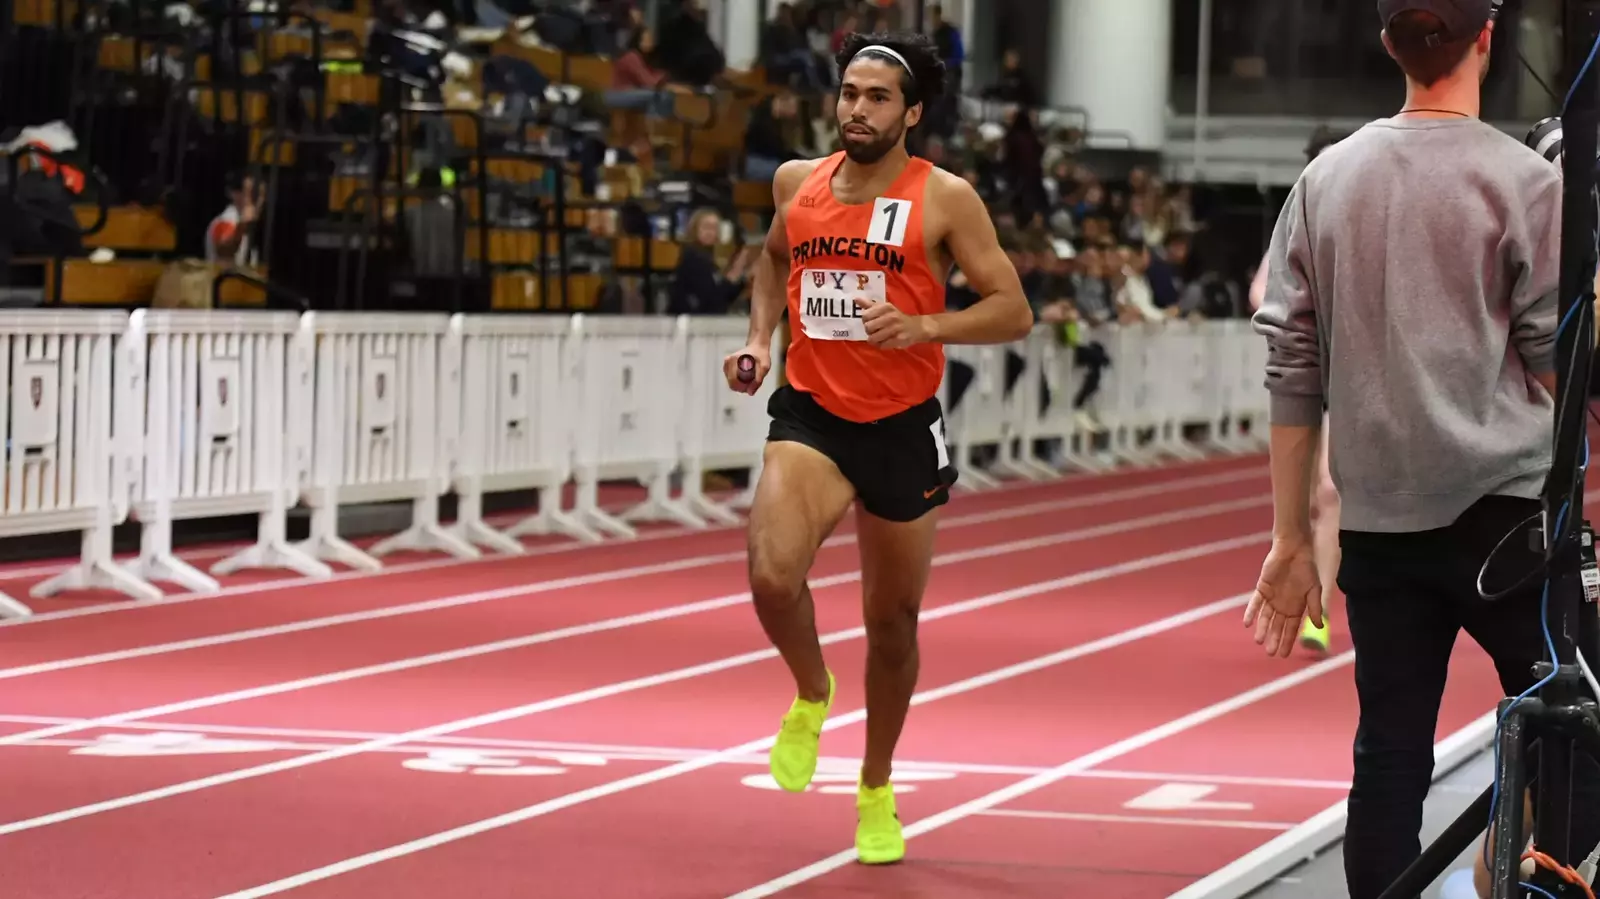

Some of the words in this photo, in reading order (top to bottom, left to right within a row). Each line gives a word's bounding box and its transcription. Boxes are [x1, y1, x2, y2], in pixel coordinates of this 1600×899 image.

[883, 202, 899, 241] 1
[792, 237, 905, 273] PRINCETON
[830, 272, 846, 290] Y
[856, 273, 869, 290] P
[806, 297, 876, 318] MILLE
